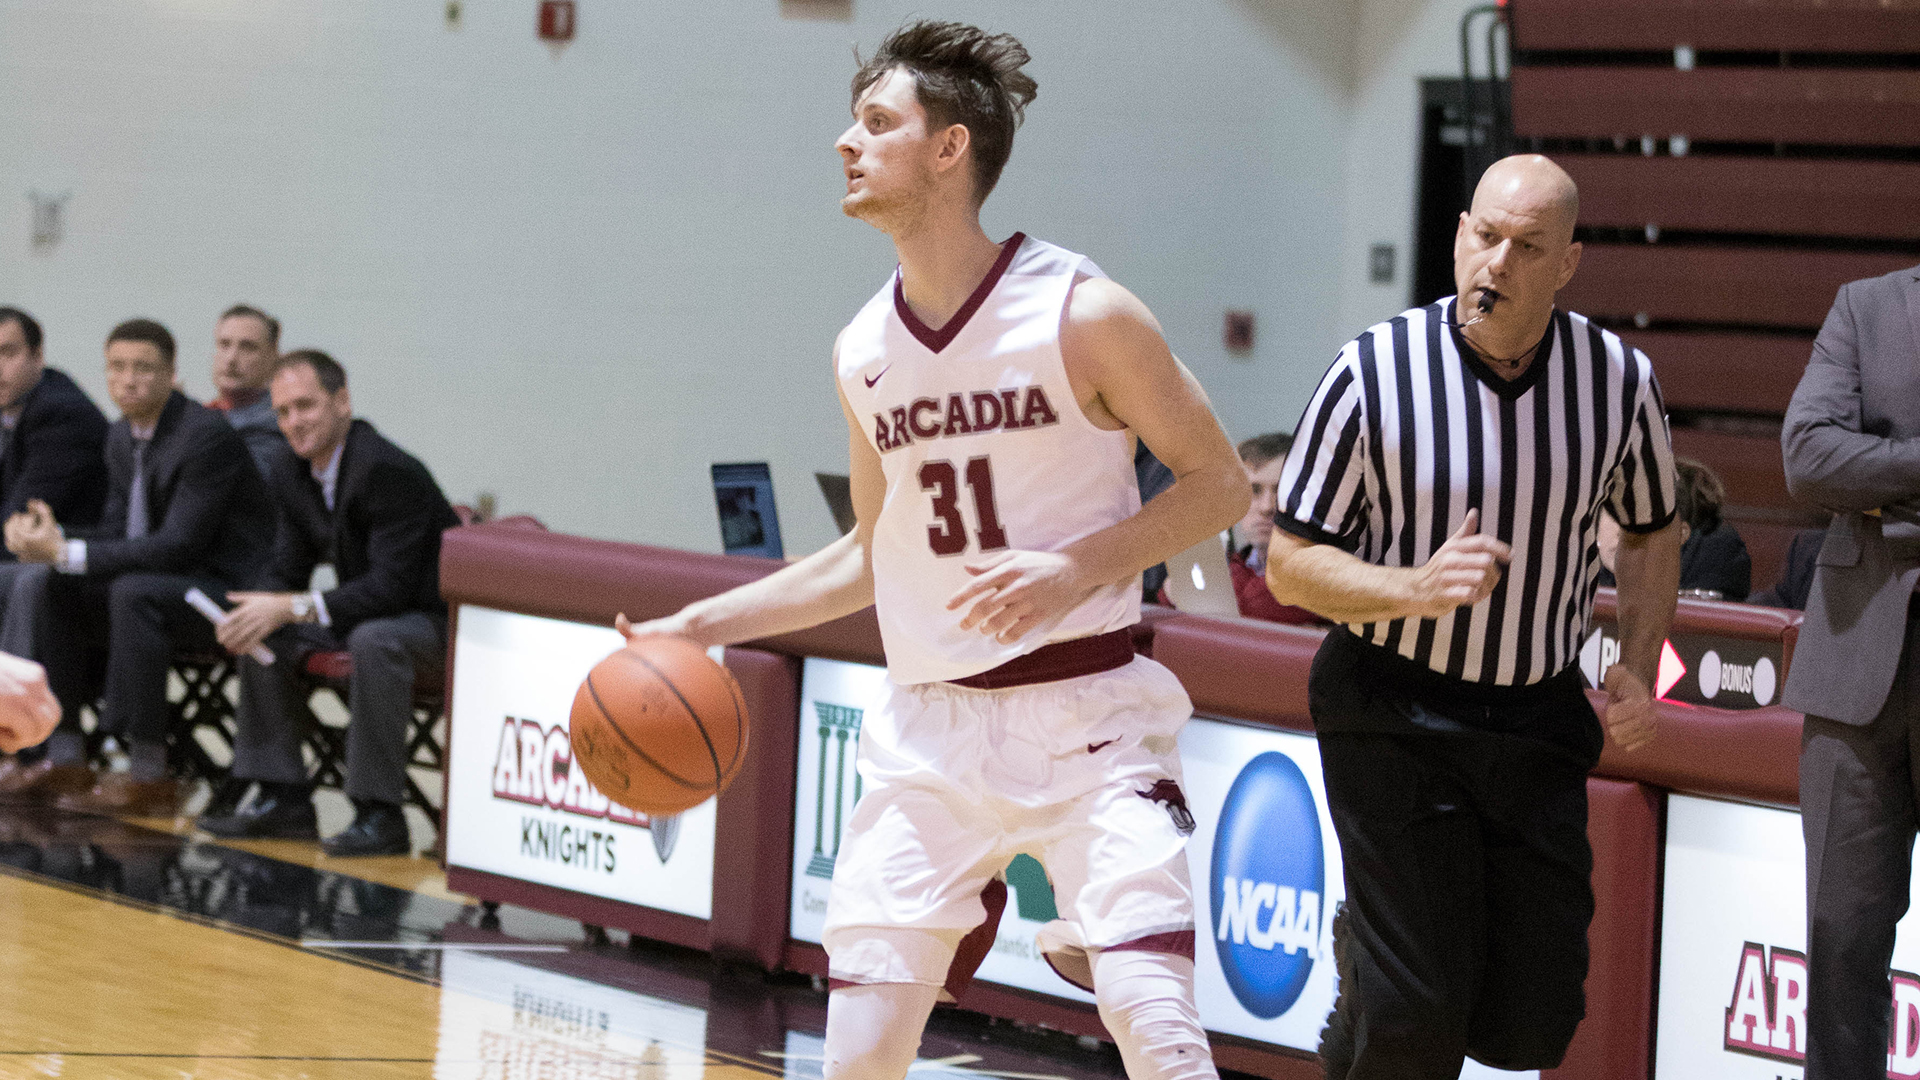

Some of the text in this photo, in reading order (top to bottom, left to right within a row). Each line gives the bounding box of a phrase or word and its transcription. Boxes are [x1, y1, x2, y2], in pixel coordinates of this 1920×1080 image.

[873, 385, 1060, 455] ARCADIA
[916, 454, 1010, 558] 31
[1720, 663, 1752, 694] BONUS
[520, 815, 617, 873] KNIGHTS
[1217, 876, 1320, 960] NCAA
